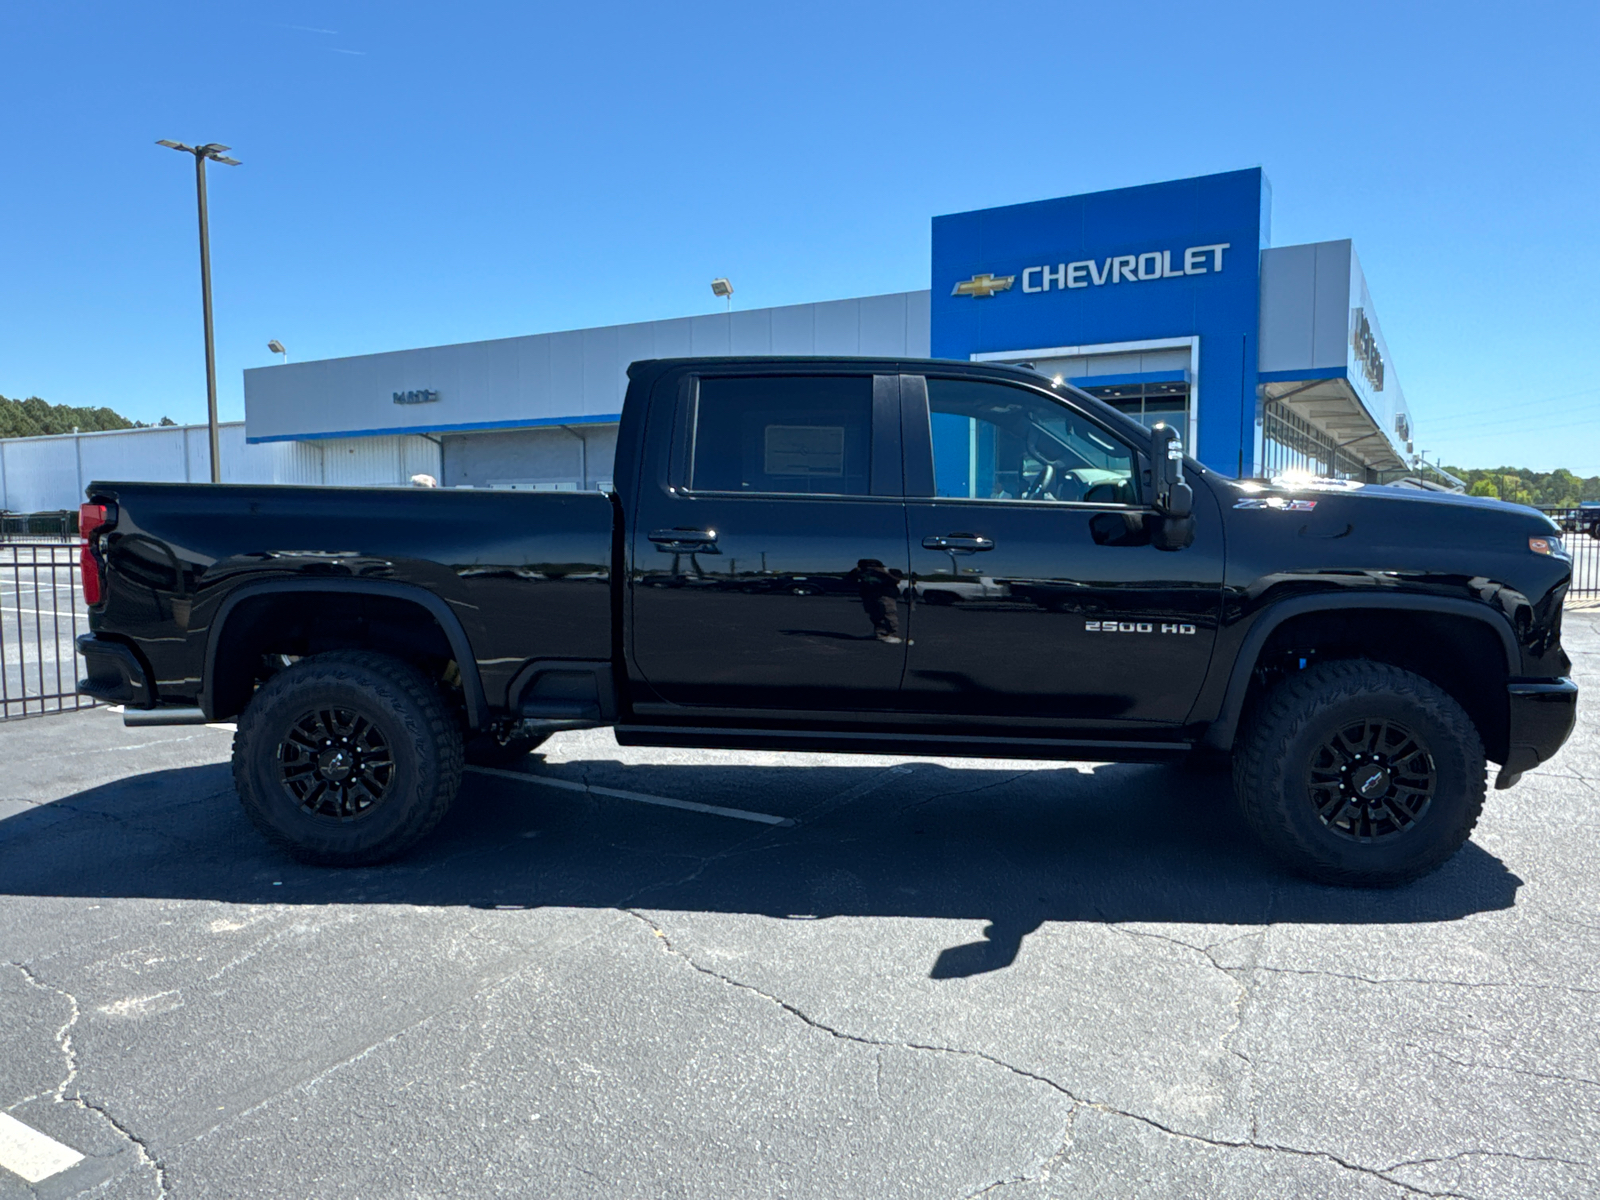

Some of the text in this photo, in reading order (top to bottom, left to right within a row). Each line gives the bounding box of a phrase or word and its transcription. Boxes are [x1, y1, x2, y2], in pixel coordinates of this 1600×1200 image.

[1021, 242, 1231, 294] CHEVROLET
[1085, 620, 1197, 635] 2500 HD
